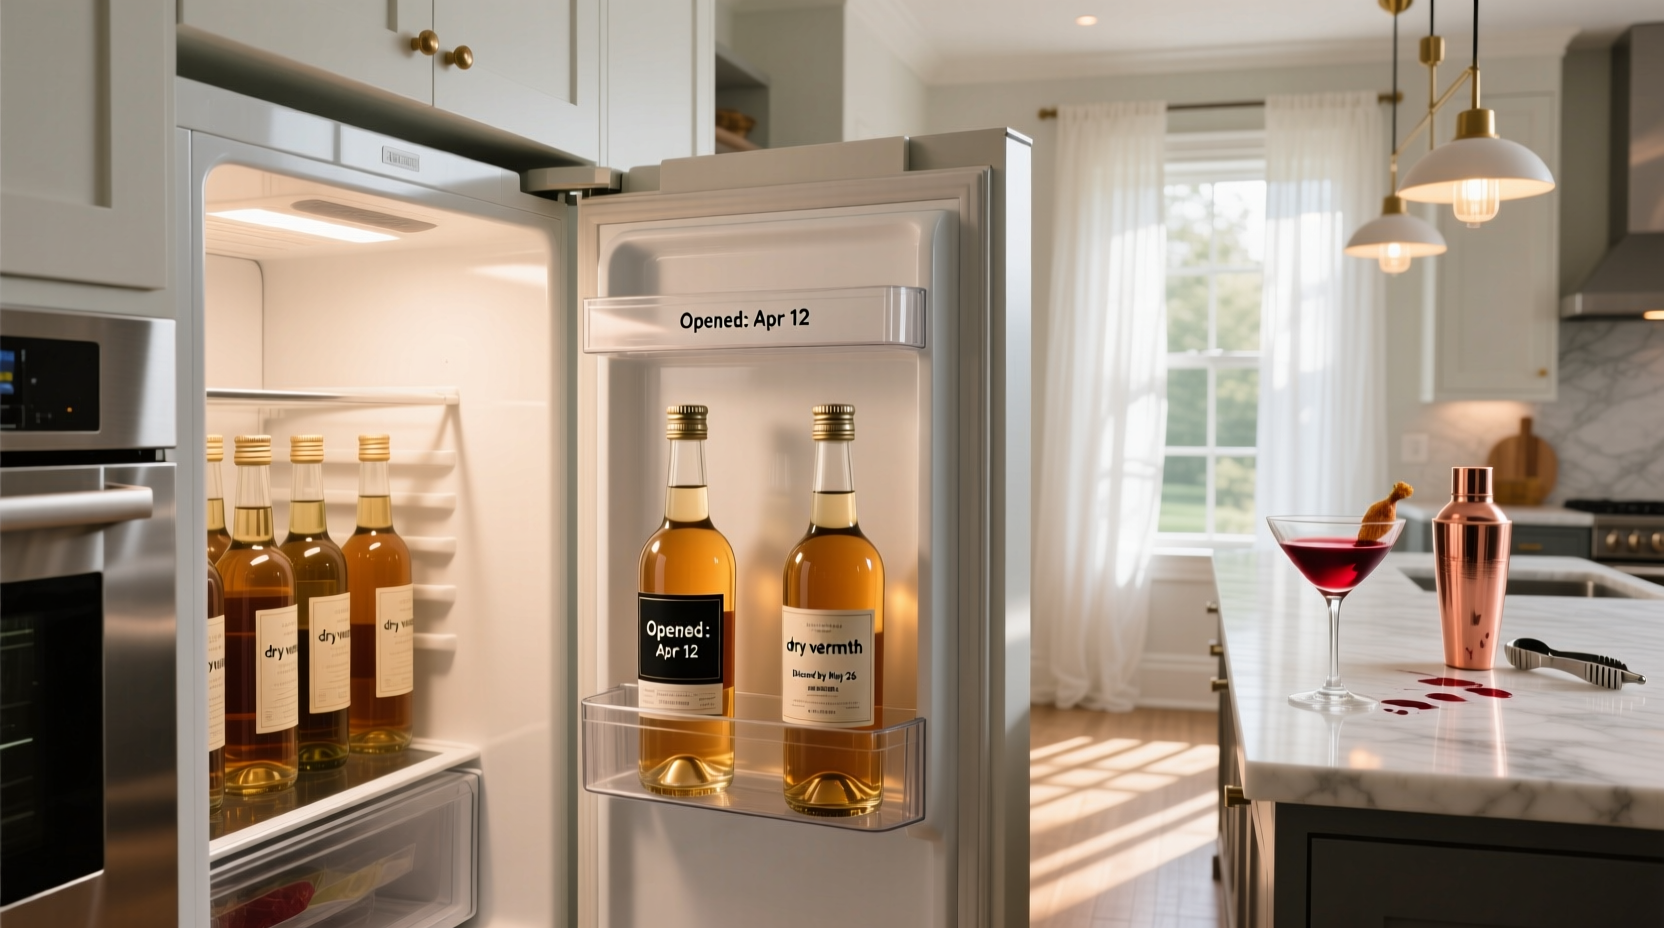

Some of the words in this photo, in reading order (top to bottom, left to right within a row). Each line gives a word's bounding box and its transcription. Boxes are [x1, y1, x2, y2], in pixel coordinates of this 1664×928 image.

[680, 310, 748, 333] Opened:
[753, 309, 785, 331] Apr
[790, 308, 810, 326] 12
[318, 629, 336, 644] dry
[646, 620, 710, 641] Opened:
[264, 645, 284, 660] dry
[655, 643, 680, 660] Apr
[683, 644, 698, 659] 12
[786, 636, 806, 657] dry
[809, 639, 863, 655] vermth
[846, 671, 857, 681] 26
